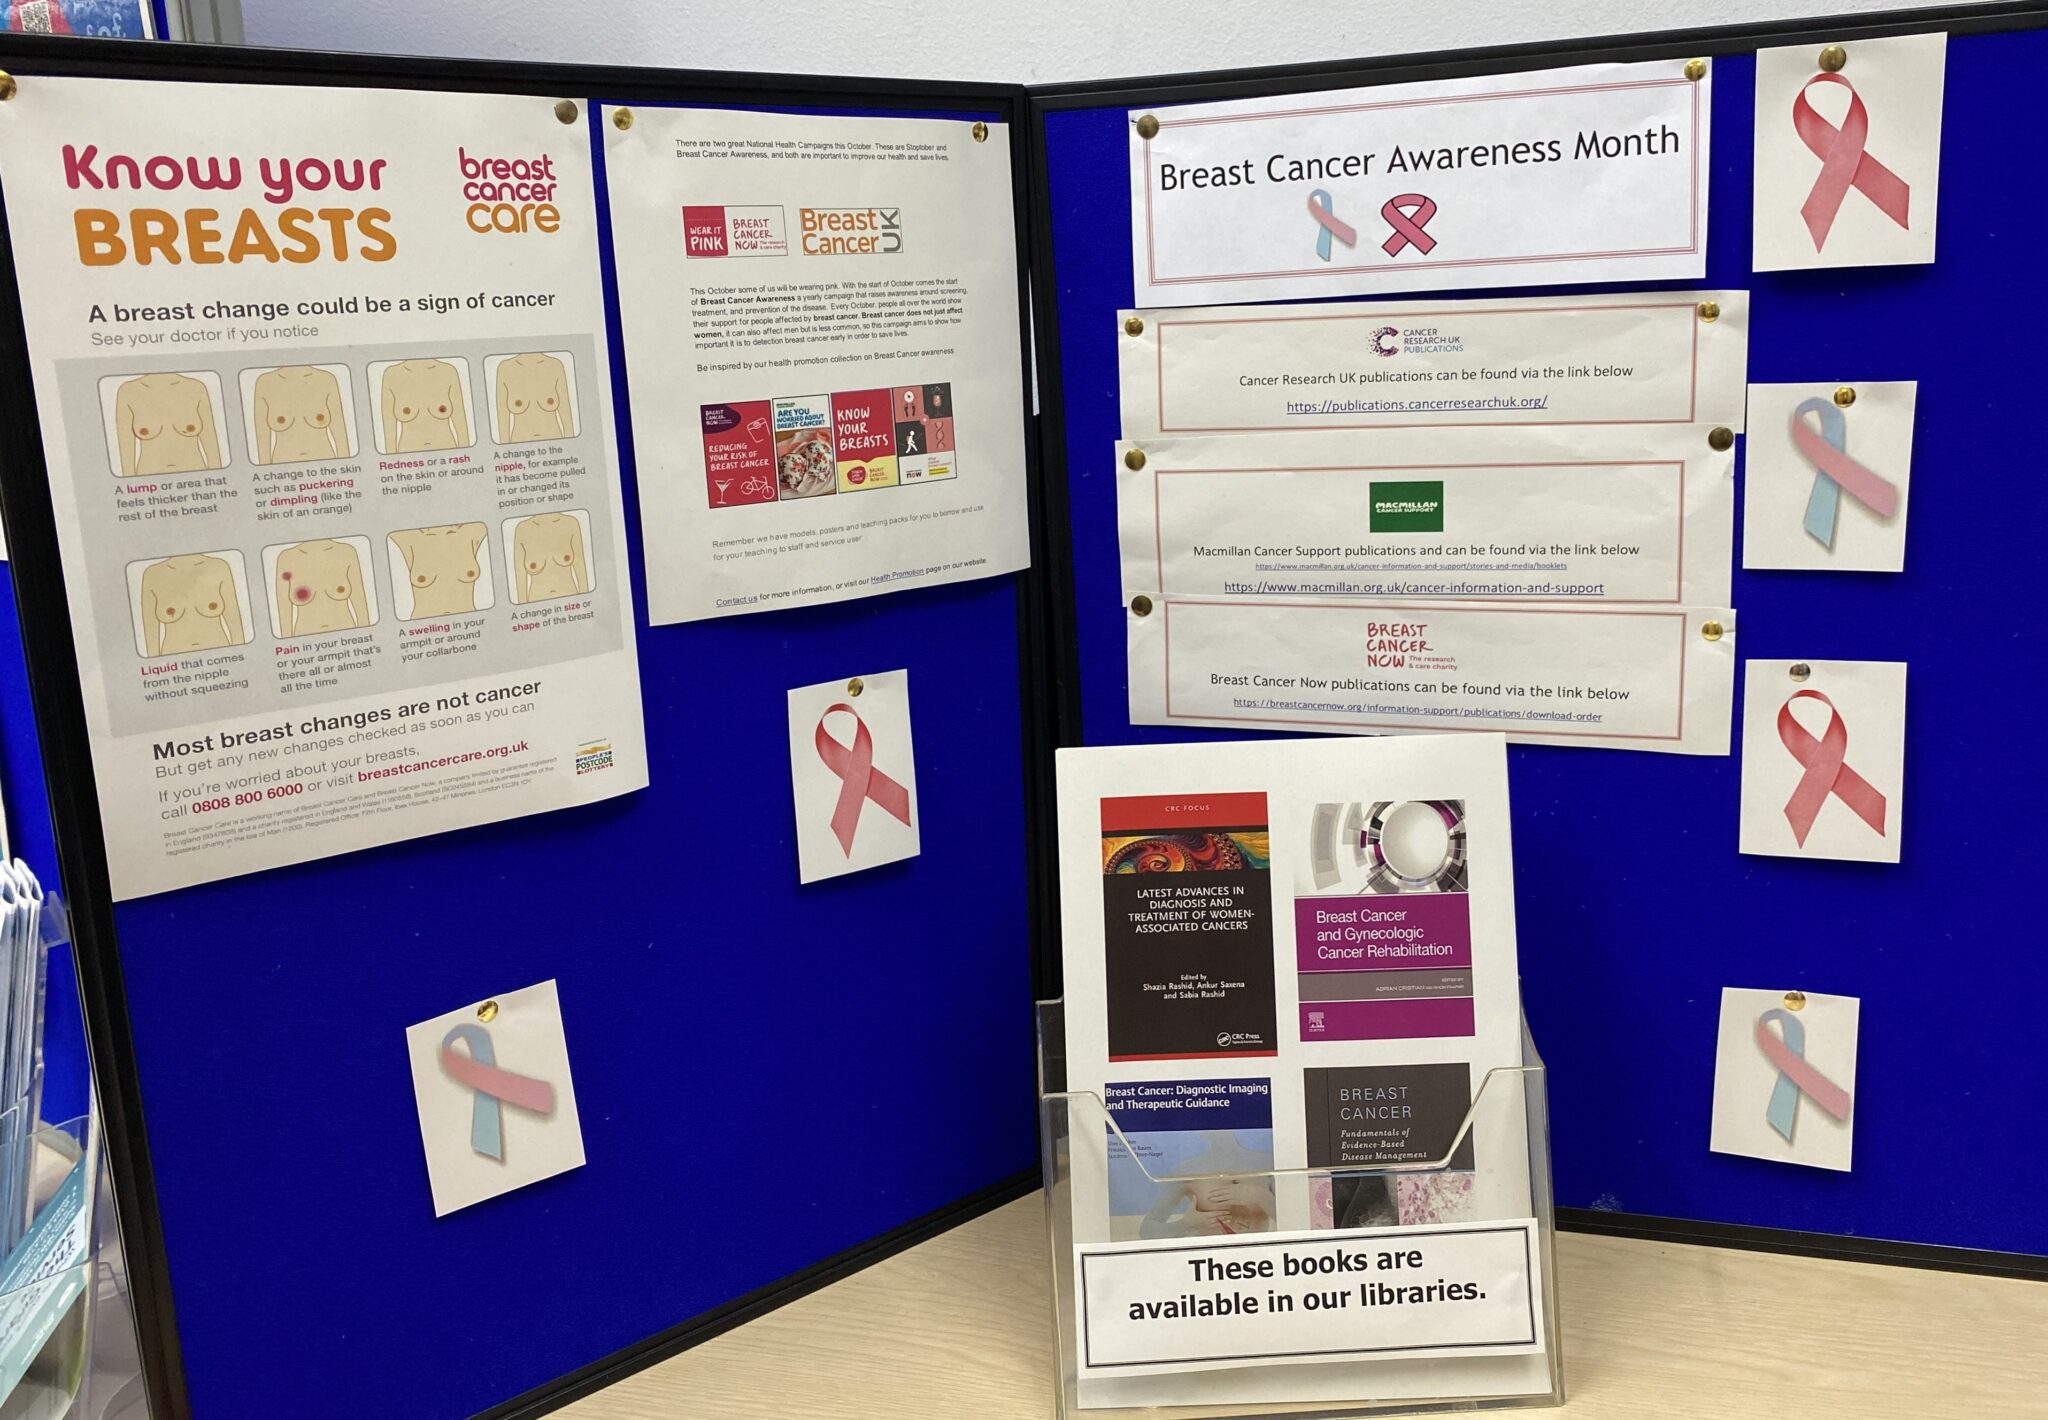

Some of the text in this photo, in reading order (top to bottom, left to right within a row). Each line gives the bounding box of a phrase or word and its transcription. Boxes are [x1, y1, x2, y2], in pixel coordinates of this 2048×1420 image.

[458, 147, 556, 180] breast
[1161, 124, 1678, 190] Breast Cancer Awareness Month
[62, 144, 386, 203] Know your
[464, 180, 556, 202] cancer
[466, 202, 560, 234] care
[733, 218, 769, 229] BREAST
[802, 210, 878, 231] Breast
[74, 208, 398, 266] BREASTS
[734, 230, 772, 240] CANCER
[880, 210, 901, 252] UK
[690, 236, 724, 250] PINK
[736, 241, 758, 250] NOW
[803, 233, 879, 253] Cancer
[89, 292, 554, 322] A breast change could be a sign of cancer
[91, 324, 318, 347] See your doctor if you notice
[1404, 345, 1464, 353] PUBLICATIONS
[697, 364, 708, 372] Be
[710, 362, 742, 372] inspired
[743, 361, 752, 370] by
[769, 359, 792, 367] health
[794, 357, 828, 366] promotion
[830, 354, 862, 363] collection
[921, 348, 954, 356] awareness
[1240, 376, 1278, 386] Cancer
[1283, 372, 1334, 384] Research
[1339, 372, 1355, 383] UK
[1360, 371, 1432, 384] publications
[1462, 369, 1476, 379] be
[1480, 367, 1516, 379] found
[1521, 368, 1538, 378] via
[1543, 366, 1563, 377] the
[1568, 366, 1589, 377] link
[1594, 365, 1633, 376] below
[837, 406, 870, 418] KNOW
[1286, 395, 1547, 414] https://publications.cancerresearchuk.org/
[838, 424, 868, 436] YOUR
[708, 442, 748, 452] REDUCING
[840, 435, 889, 451] BREASTS
[710, 458, 768, 471] BREAST CANCER
[115, 485, 123, 494] A
[127, 484, 157, 493] lump
[176, 480, 201, 488] area
[204, 476, 226, 485] that
[117, 489, 237, 508] feels thicker than the
[118, 504, 217, 521] rest of the breast
[1224, 581, 1604, 595] https://www.macmillan.org.uk/cancer-information-and-support
[1368, 623, 1427, 638] BREAST
[1367, 640, 1433, 652] CANCER
[1368, 654, 1404, 668] NOW
[153, 682, 540, 759] Most breast changes are not cancer
[162, 740, 528, 819] call 0808 800 6000 or visit breastcancercare.org.uk
[1137, 886, 1243, 898] LATEST ADVANCES IN
[1150, 898, 1232, 908] DIAGNOSIS AND
[1128, 909, 1254, 921] TREATMENT OF WOMEN-
[1316, 909, 1406, 923] Breast Cancer
[1136, 921, 1247, 932] ASSOCIATED CANCERS
[1317, 925, 1423, 942] and Gynecologic
[1318, 942, 1452, 958] Cancer Rehabilitation
[1105, 1084, 1268, 1098] Breast Cancer: Diagnostic Imaging
[1340, 1087, 1407, 1100] BREAST
[1106, 1098, 1230, 1110] and Therapeutic Guidance
[1341, 1106, 1410, 1119] CANCER
[1341, 1128, 1410, 1137] Fundamentals of
[1341, 1140, 1404, 1148] Evidence-Based
[1375, 1152, 1426, 1160] Management
[1188, 1249, 1422, 1281] These books are
[1129, 1280, 1485, 1320] available in our libraries.
